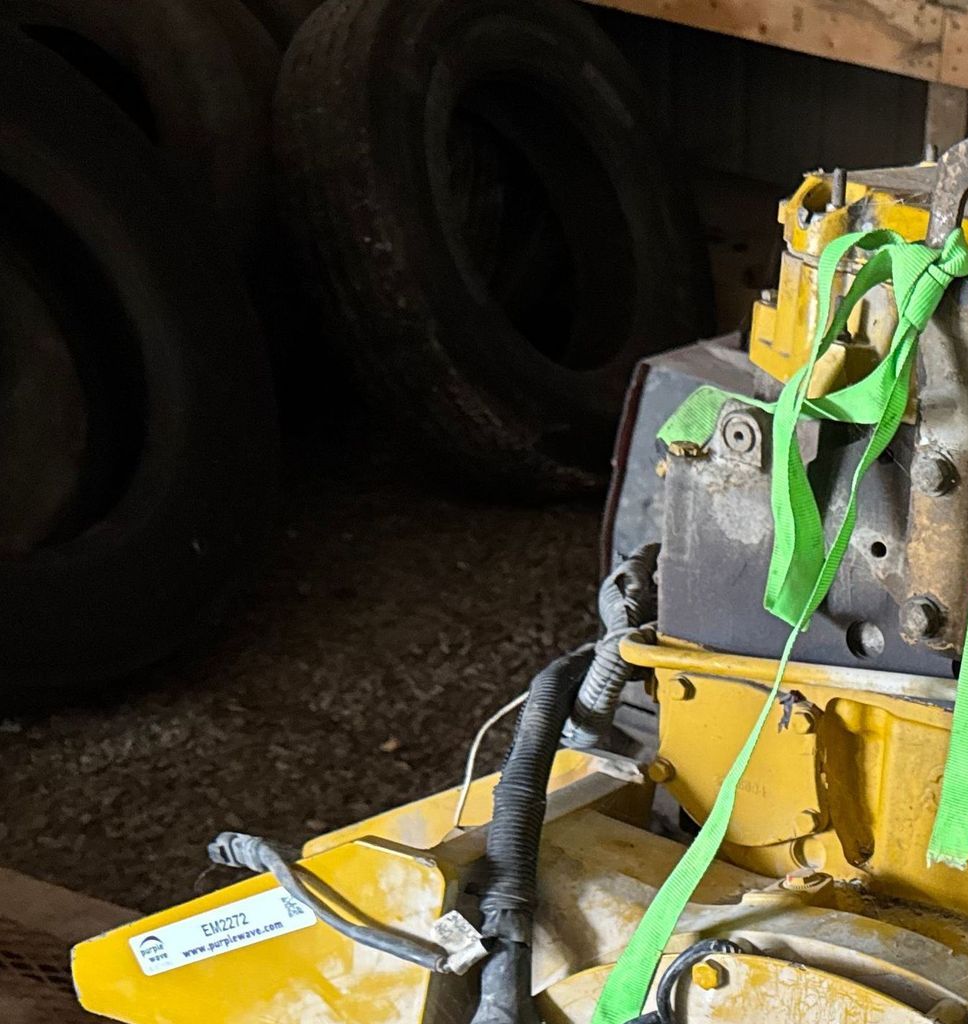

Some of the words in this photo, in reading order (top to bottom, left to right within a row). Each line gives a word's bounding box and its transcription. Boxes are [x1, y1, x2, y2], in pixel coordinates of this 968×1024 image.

[201, 912, 249, 938] EM2272
[182, 919, 284, 959] www.purplewave.com
[140, 943, 164, 958] purple
[149, 952, 168, 963] wave
